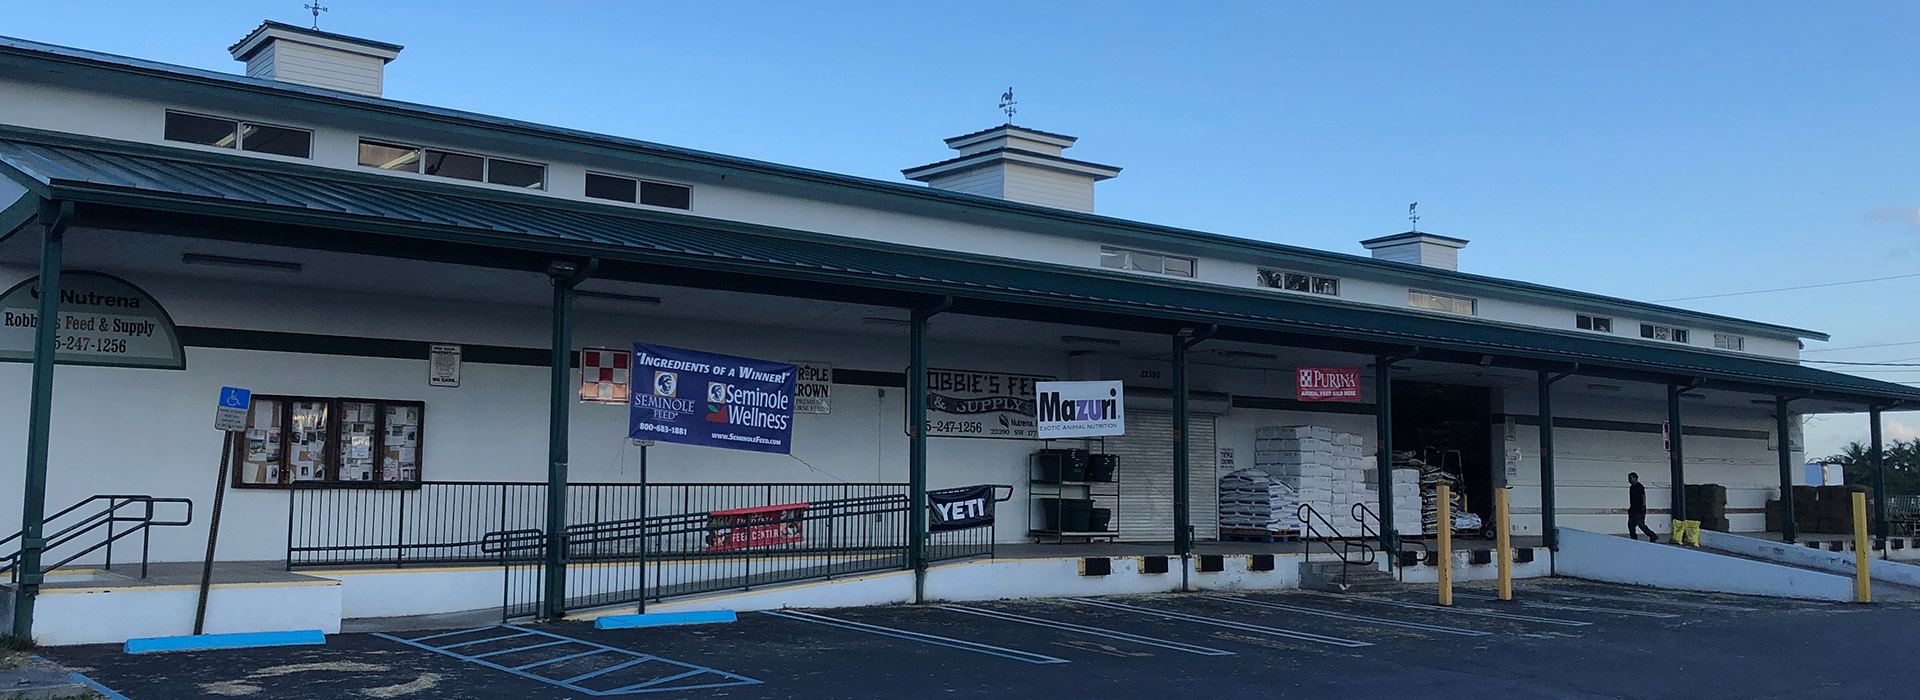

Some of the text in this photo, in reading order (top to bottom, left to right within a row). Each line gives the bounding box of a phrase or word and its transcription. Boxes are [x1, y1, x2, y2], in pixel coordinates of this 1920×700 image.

[60, 289, 140, 308] Nutrena
[5, 311, 155, 338] Robbs Feed & Supply
[55, 335, 127, 353] 5-247-1256
[713, 365, 726, 376] OF
[728, 368, 736, 377] A
[1313, 370, 1356, 389] PURINA
[795, 383, 829, 398] ROWN
[926, 371, 1001, 394] OBBIE'S
[635, 394, 695, 413] SEMINOLE
[725, 384, 789, 410] Seminole
[934, 396, 1022, 413] & SUPPLY
[1040, 387, 1117, 423] Mazuri
[653, 409, 676, 420] FEED
[728, 404, 788, 431] Wellness
[1010, 418, 1034, 427] Nutrena
[639, 422, 688, 435] 800-683-1881
[926, 420, 982, 434] 5-247-1256
[990, 428, 1011, 436] 22390
[1086, 422, 1118, 430] NUTRITION
[936, 498, 985, 522] YETI
